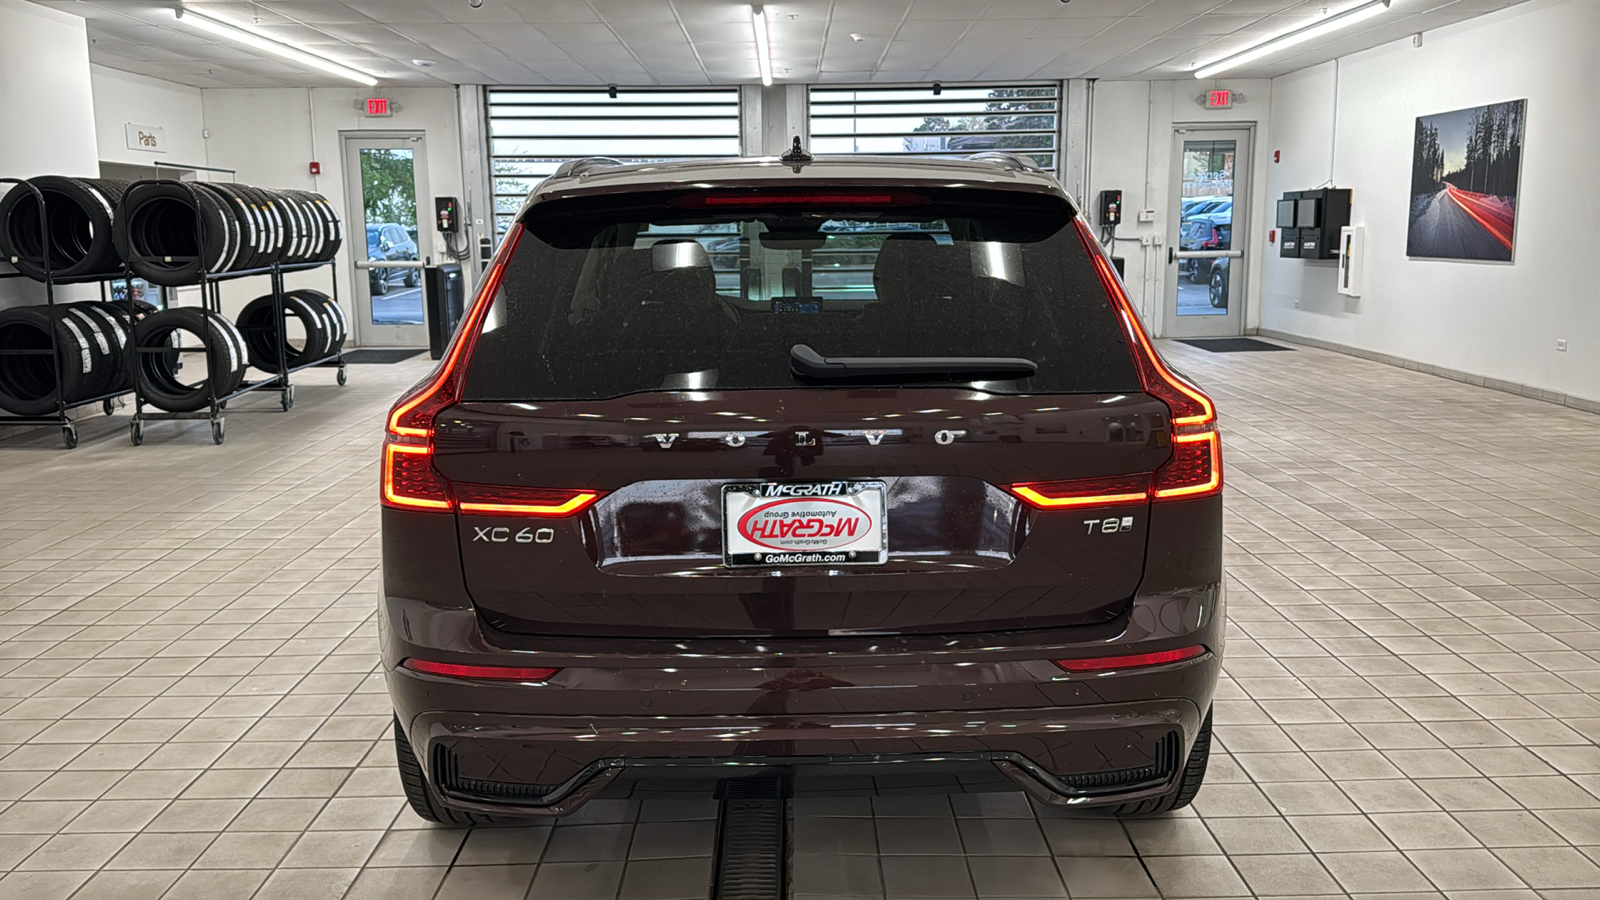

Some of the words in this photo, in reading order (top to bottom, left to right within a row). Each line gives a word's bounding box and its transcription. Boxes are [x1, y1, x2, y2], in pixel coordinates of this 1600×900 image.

[367, 98, 387, 114] EXIT
[1210, 91, 1230, 106] EXIT
[138, 131, 157, 147] Parts
[653, 430, 956, 449] VOLVO
[763, 510, 789, 519] Group
[791, 510, 837, 518] Automotive
[1083, 517, 1120, 535] T8
[765, 553, 846, 564] GoMcGrath.com
